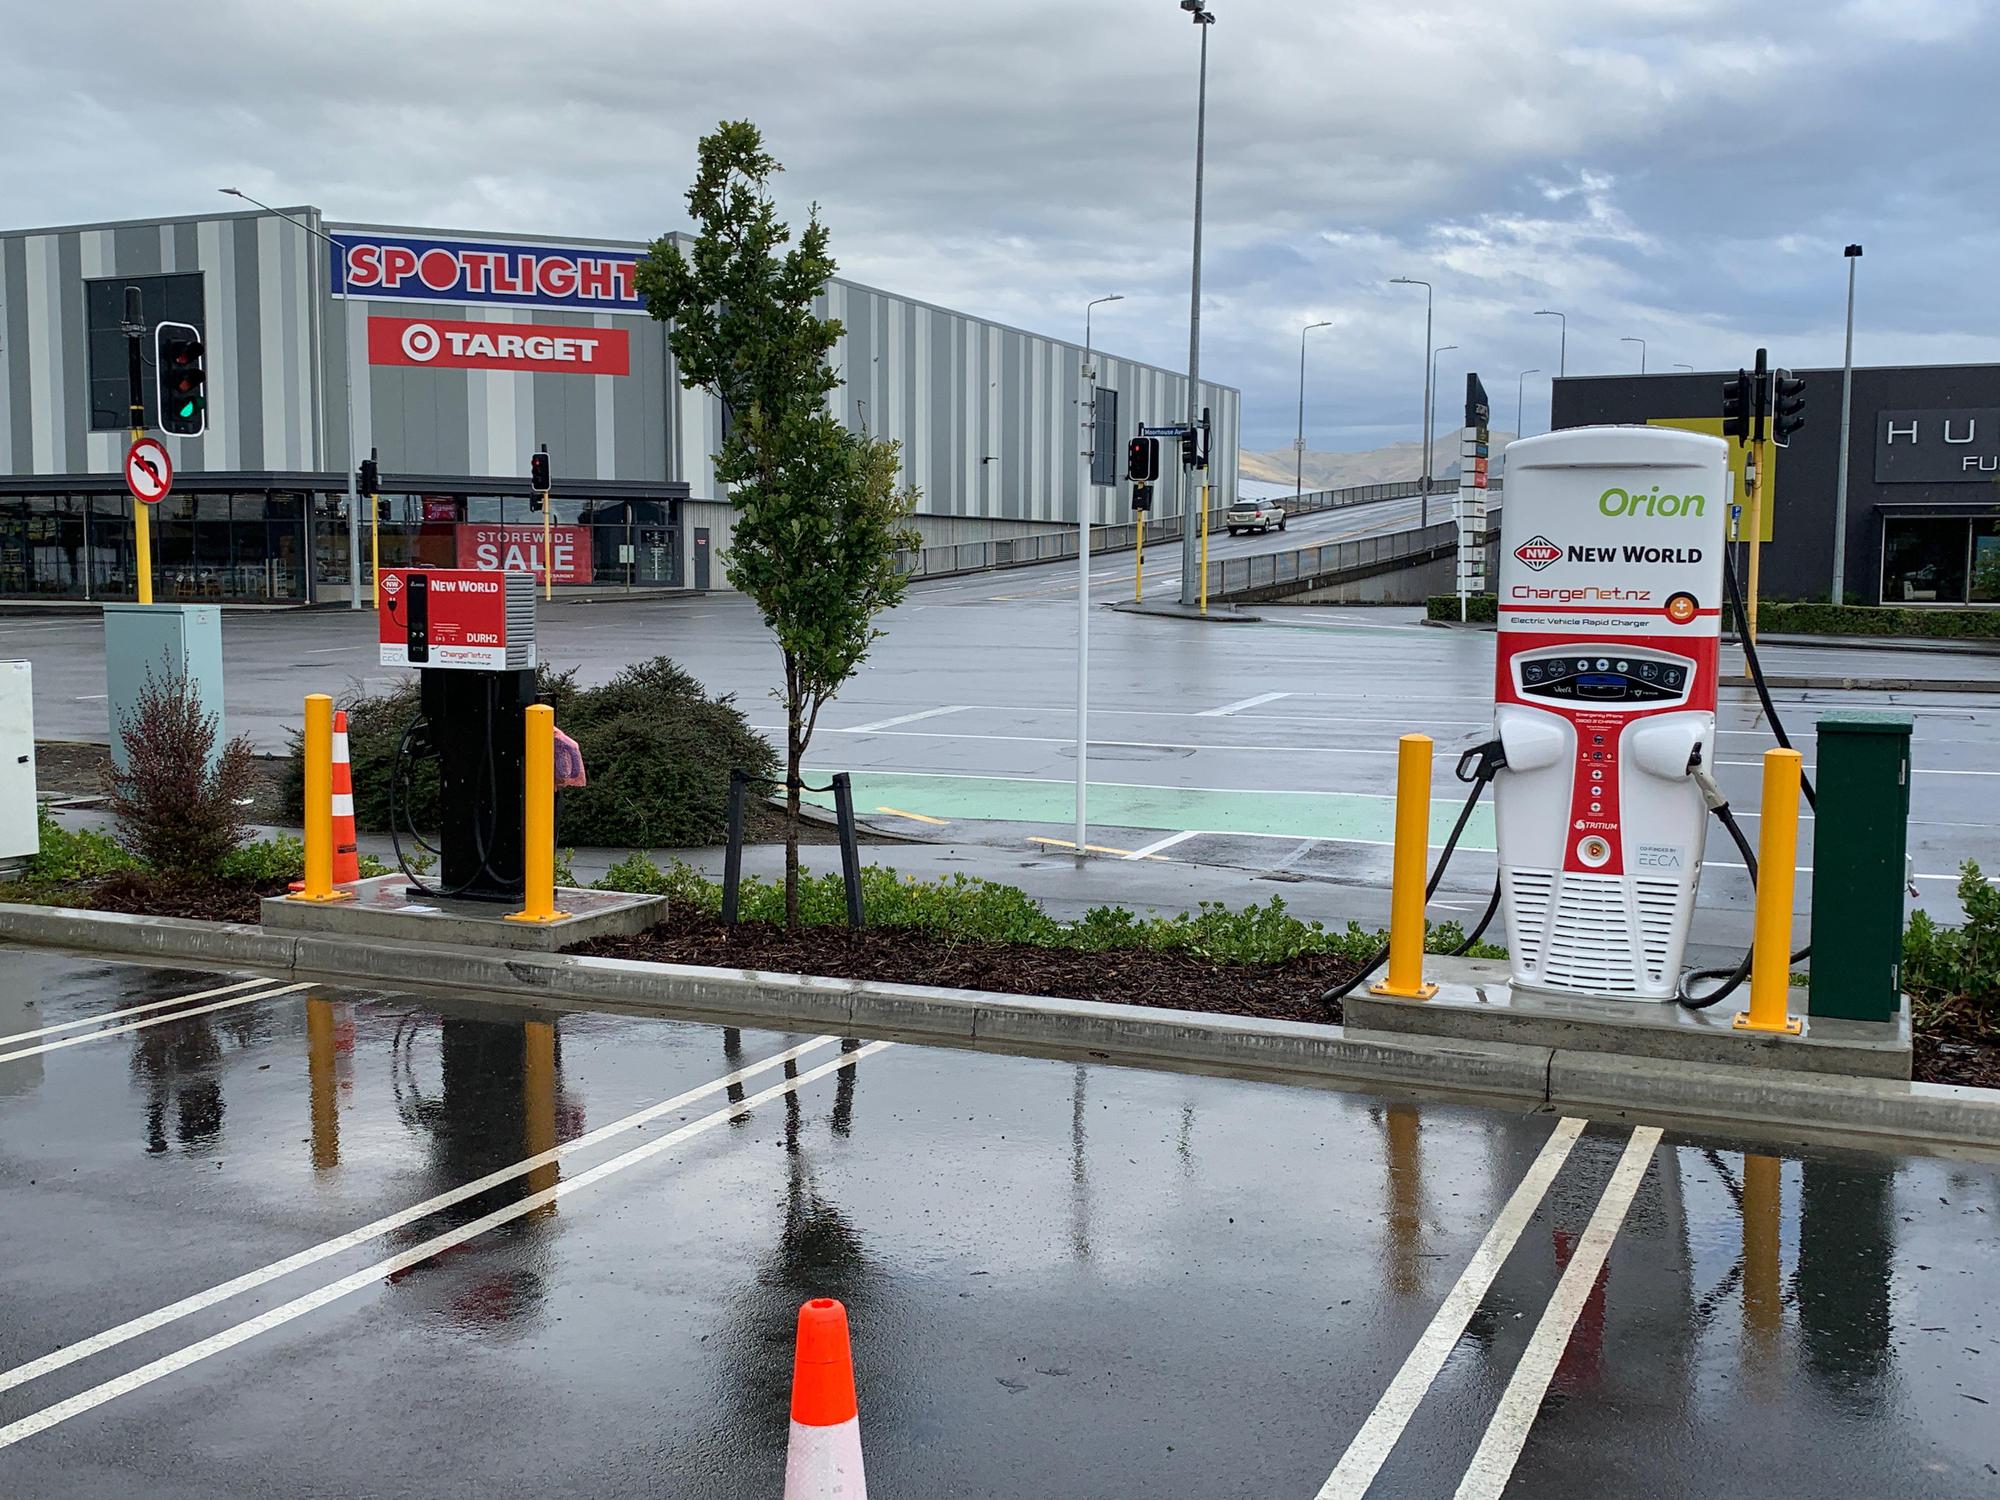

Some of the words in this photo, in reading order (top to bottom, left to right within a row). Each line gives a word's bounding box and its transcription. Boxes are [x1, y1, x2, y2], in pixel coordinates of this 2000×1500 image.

[347, 244, 638, 301] SPOTLIGHT
[445, 332, 598, 362] TARGET
[1962, 456, 2000, 471] FU
[1599, 486, 1705, 517] Orion
[476, 544, 575, 570] SALE
[1526, 548, 1551, 559] NW
[1567, 546, 1617, 562] NEW
[1623, 546, 1703, 563] WORLD
[386, 580, 399, 588] NW
[431, 580, 457, 592] NEW
[458, 580, 499, 593] WORLD
[1512, 585, 1651, 602] ChargeNet.nz
[1511, 617, 1545, 625] Electric
[1611, 619, 1650, 627] Charger
[466, 633, 498, 643] DURH2
[1586, 821, 1617, 830] TRITIUM
